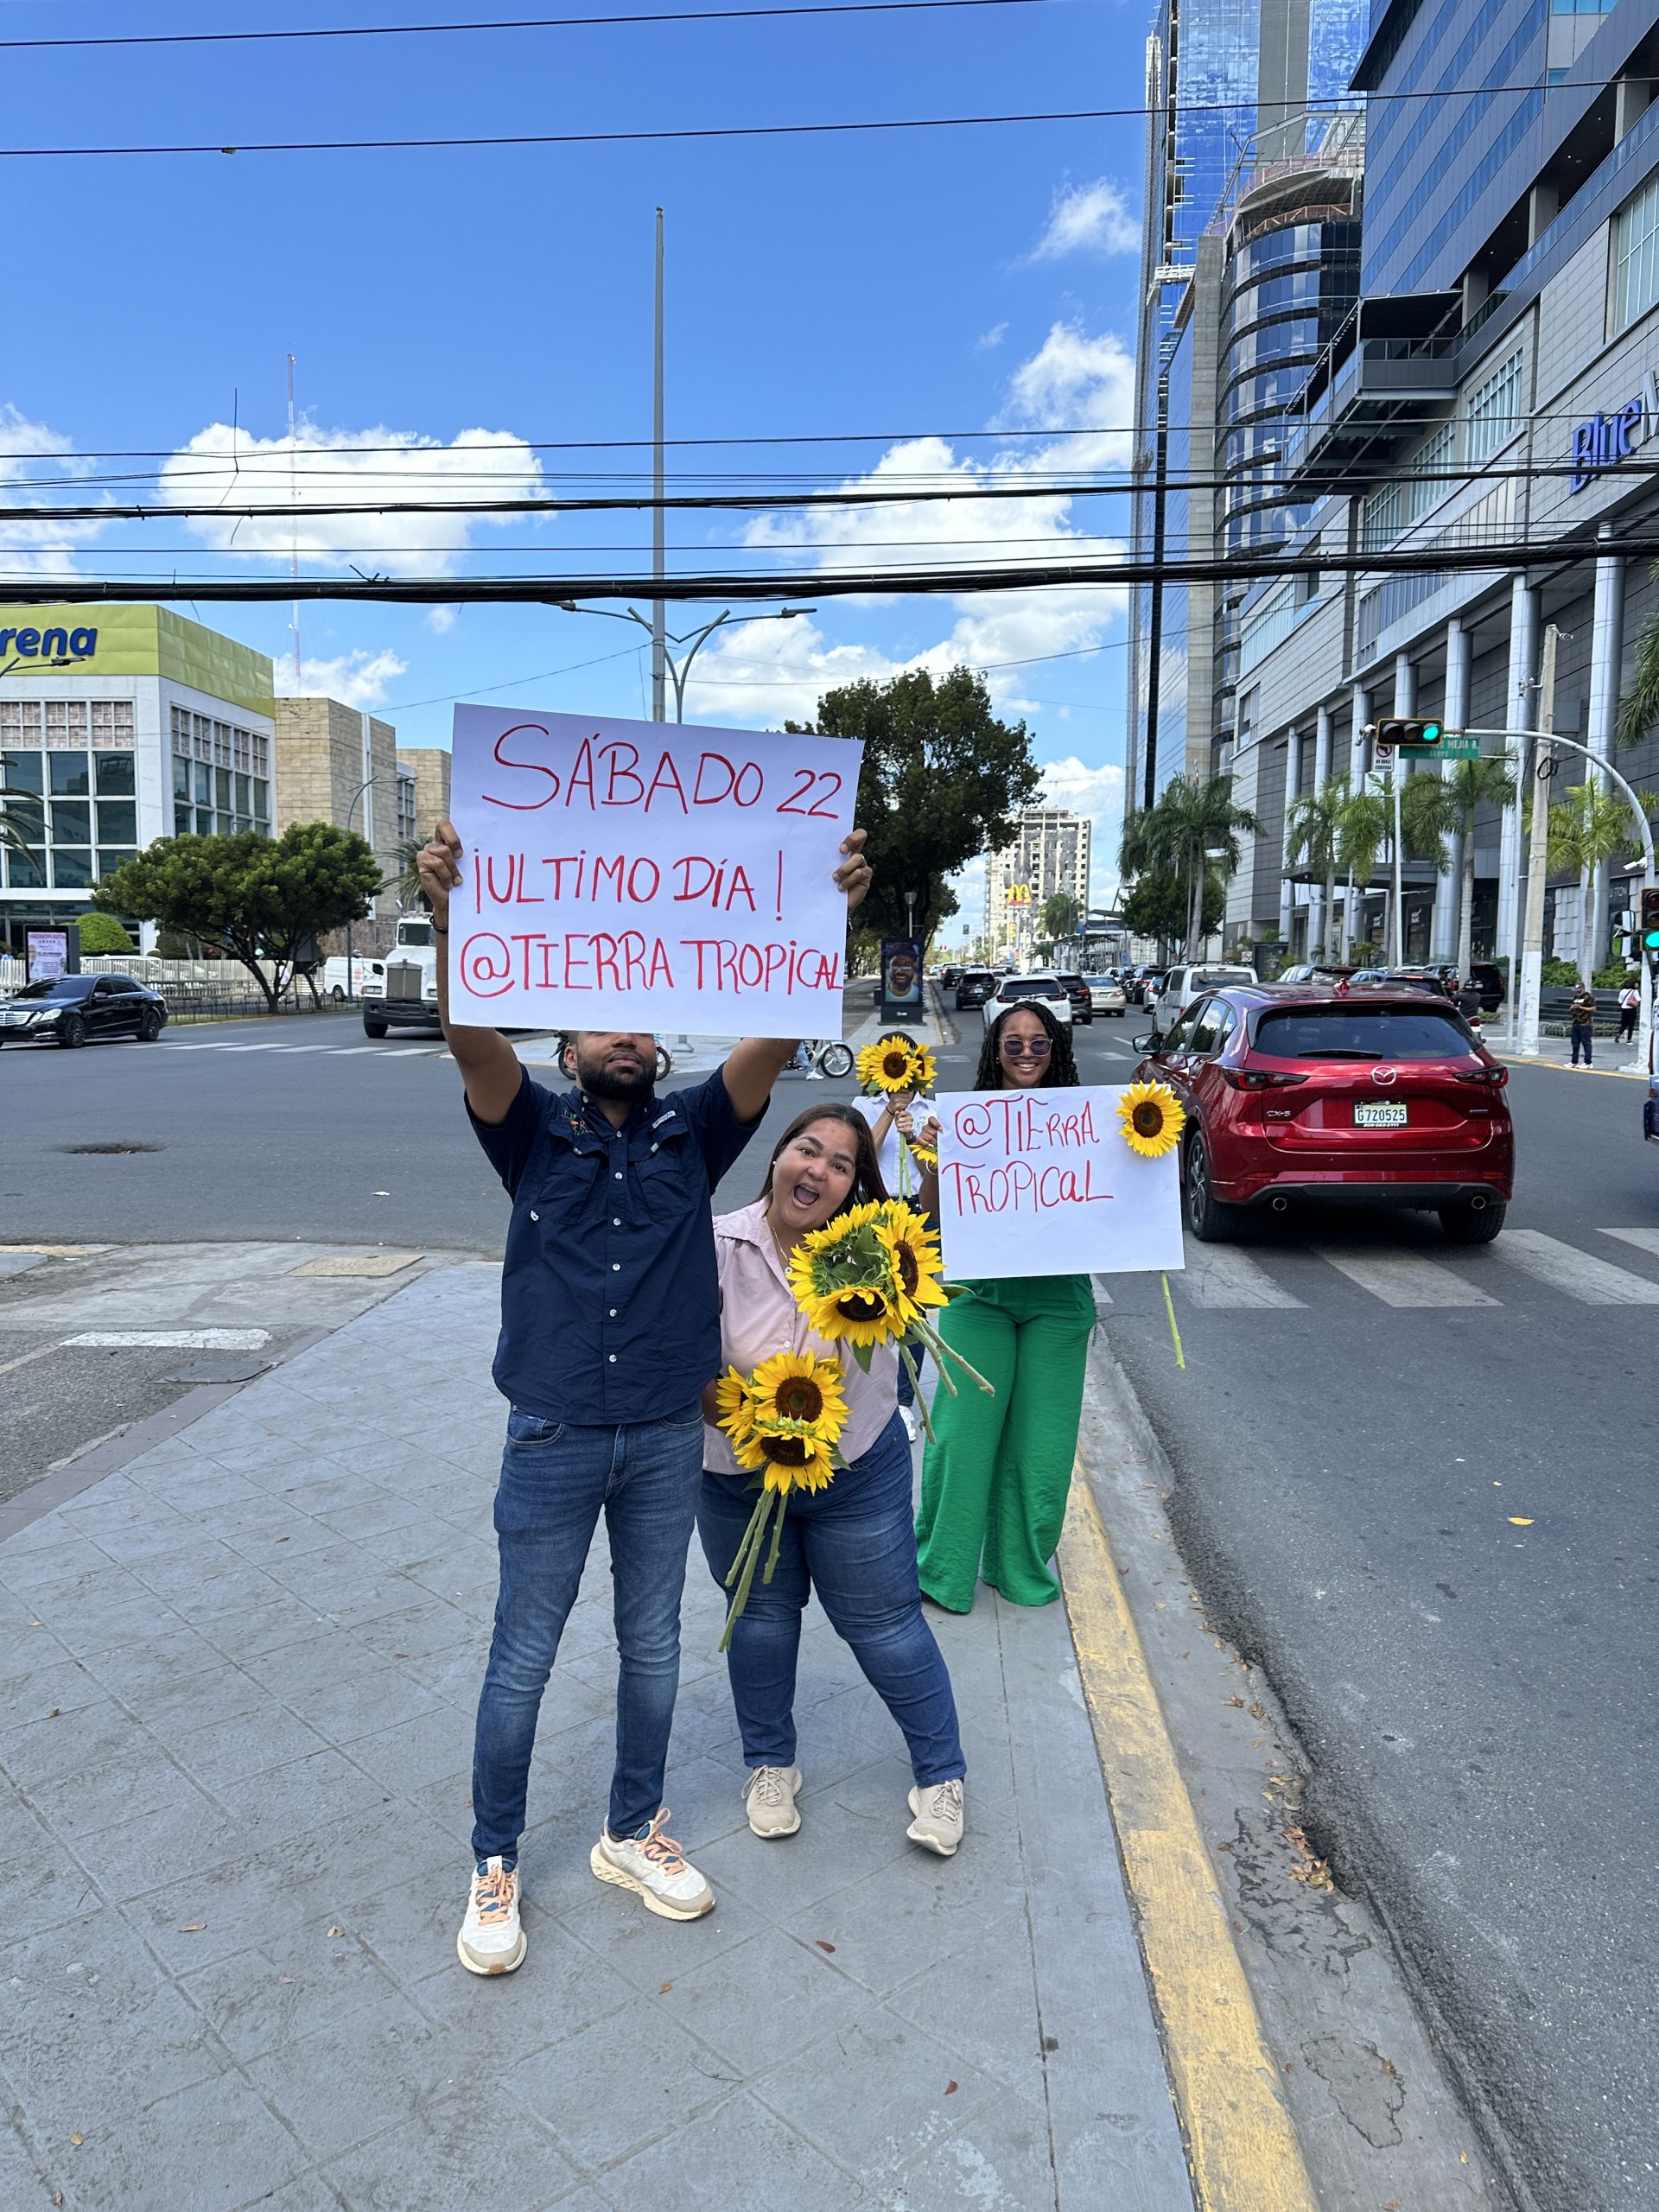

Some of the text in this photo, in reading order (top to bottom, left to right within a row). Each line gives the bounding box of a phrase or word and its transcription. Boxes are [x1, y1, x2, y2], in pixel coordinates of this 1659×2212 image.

[0, 627, 98, 657] rena
[481, 723, 842, 819] SÁBADO 22
[460, 930, 674, 998] @TIERRA
[1357, 1109, 1405, 1122] G720525
